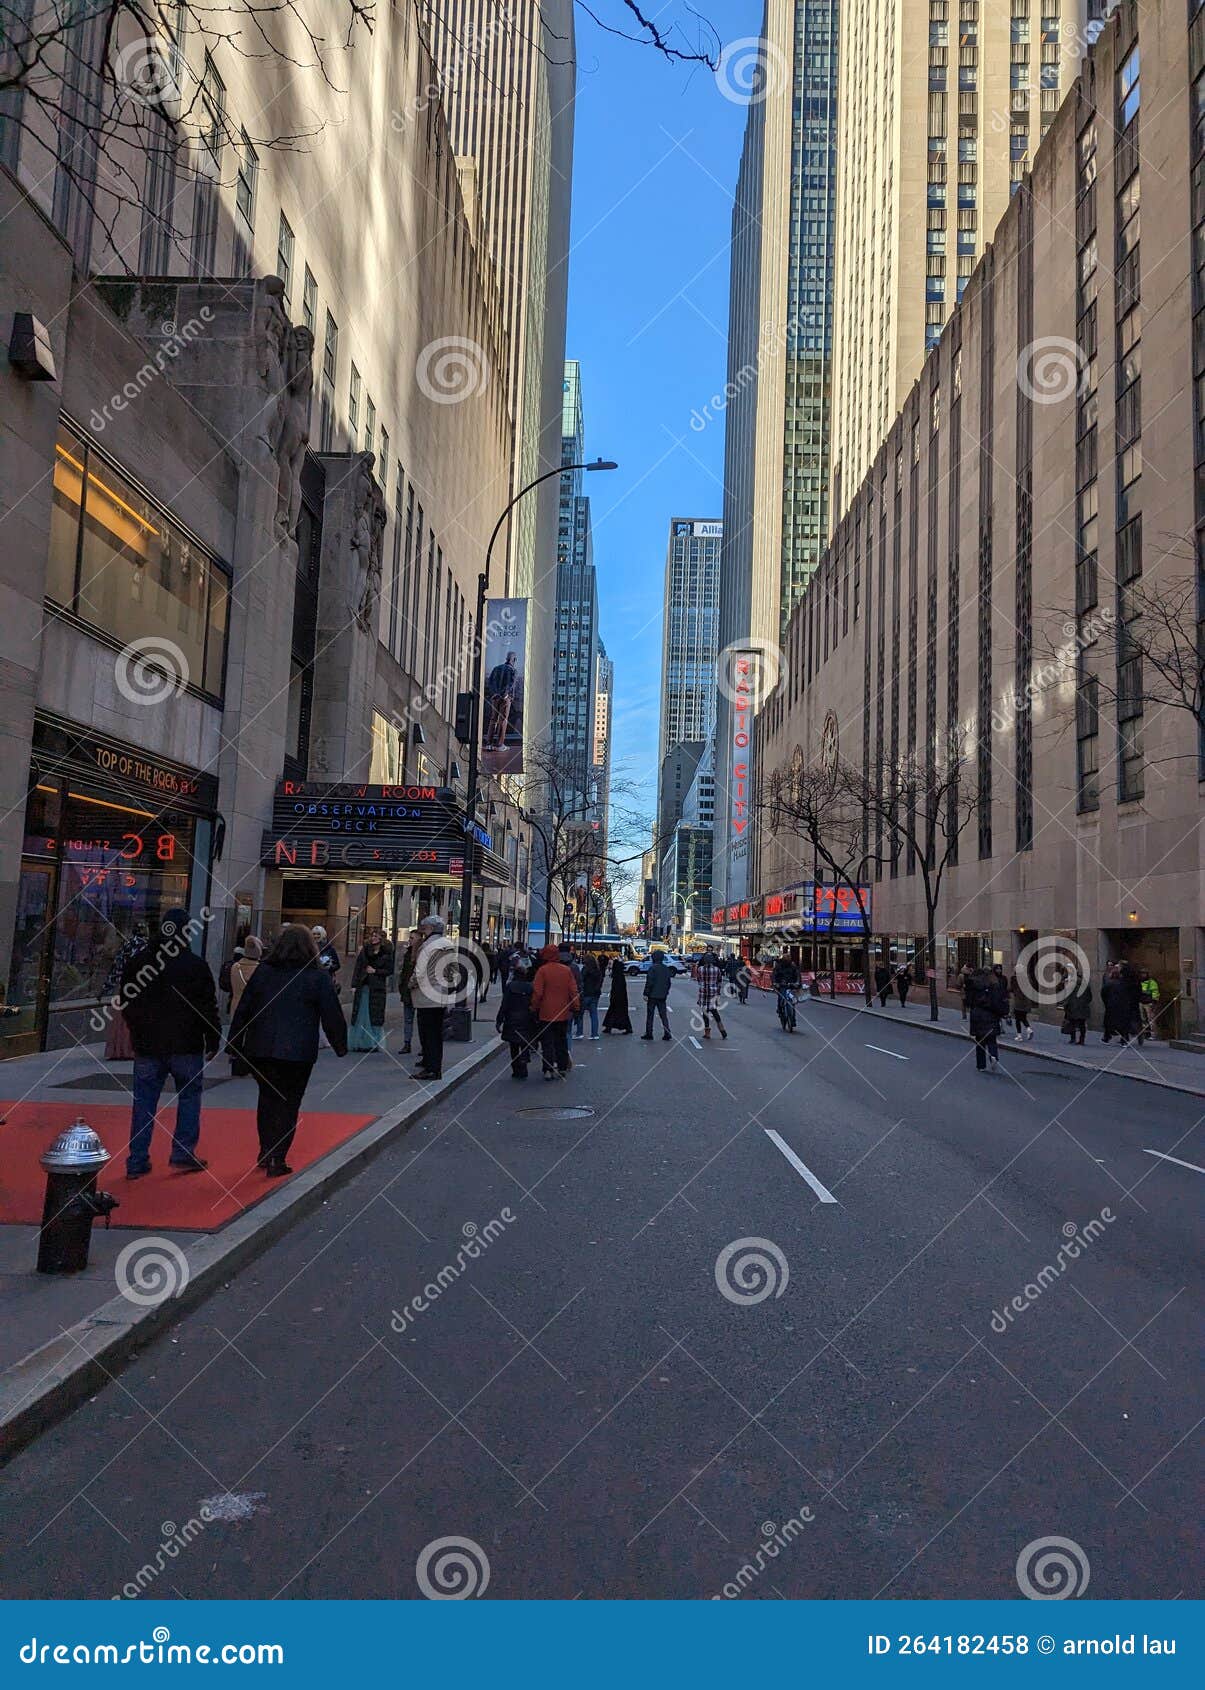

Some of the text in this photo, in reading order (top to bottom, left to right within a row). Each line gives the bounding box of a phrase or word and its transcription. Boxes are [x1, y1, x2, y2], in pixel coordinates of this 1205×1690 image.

[733, 658, 749, 835] RADIO CITY
[96, 748, 118, 770] TOP
[119, 756, 133, 775] OF
[134, 761, 152, 784] THE
[382, 786, 436, 800] ROOM
[294, 803, 422, 817] OBSERVATION
[331, 820, 377, 831] DECK
[275, 840, 371, 866] NBC
[809, 918, 840, 927] MUSC
[843, 919, 867, 928] HAL
